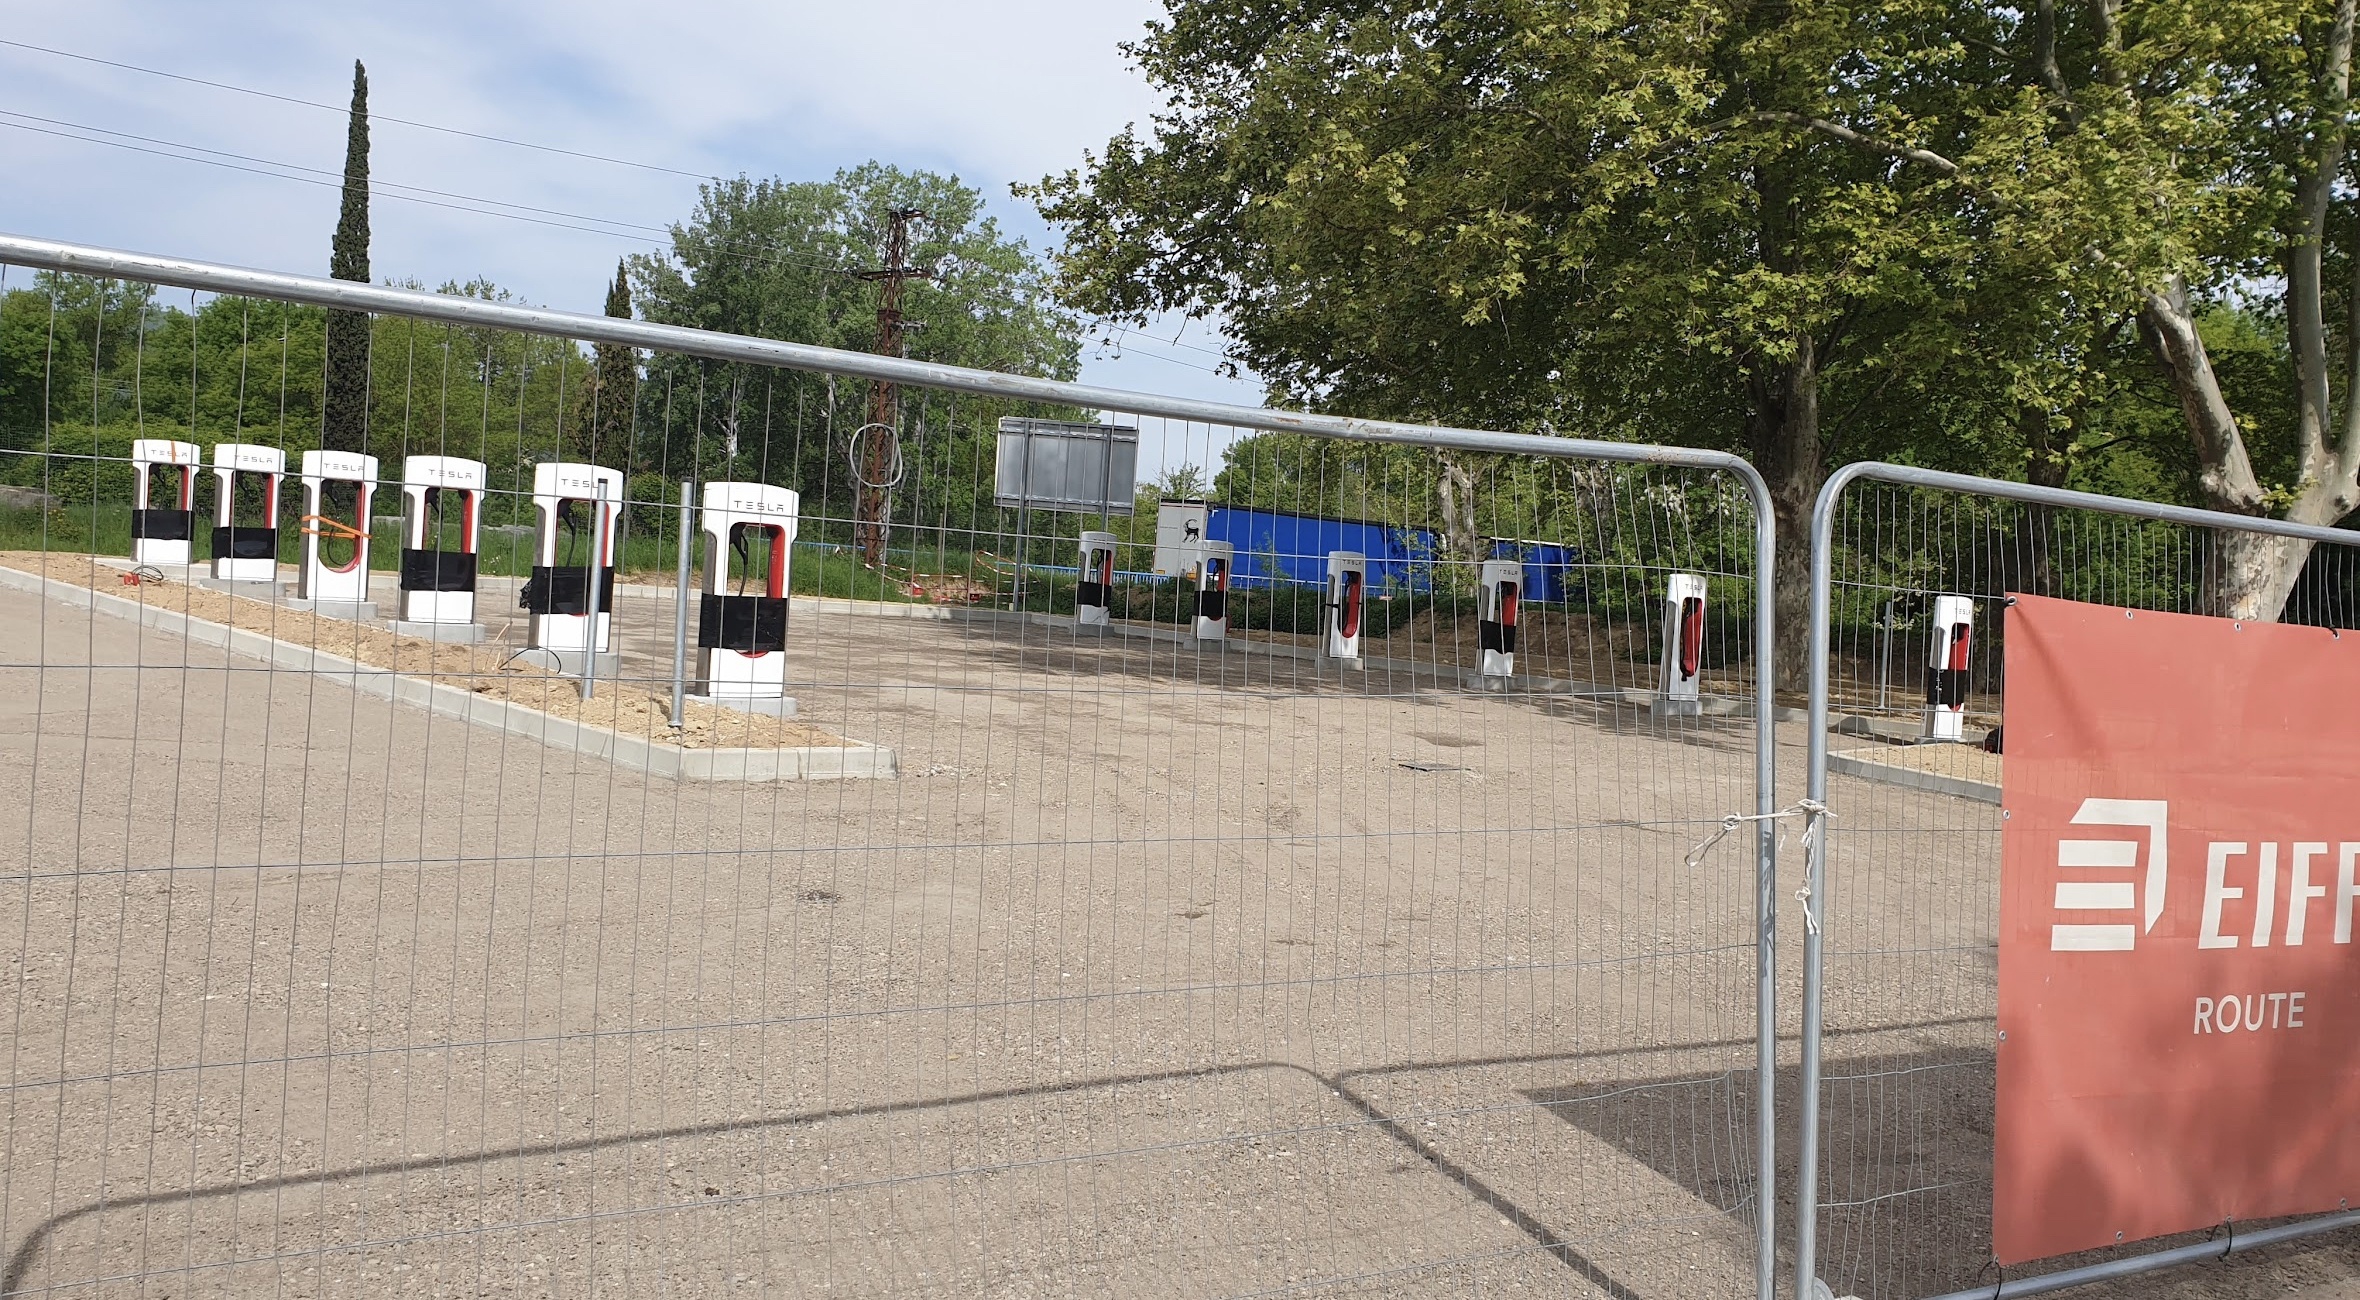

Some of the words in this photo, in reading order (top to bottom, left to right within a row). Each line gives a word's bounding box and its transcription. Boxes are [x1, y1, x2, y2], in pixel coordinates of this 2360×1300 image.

[323, 462, 365, 473] TESLA
[429, 469, 472, 479] TESLA
[561, 479, 599, 489] TESL
[733, 500, 784, 513] TESLA
[2198, 841, 2360, 949] EIFF
[2194, 992, 2306, 1034] ROUTE
